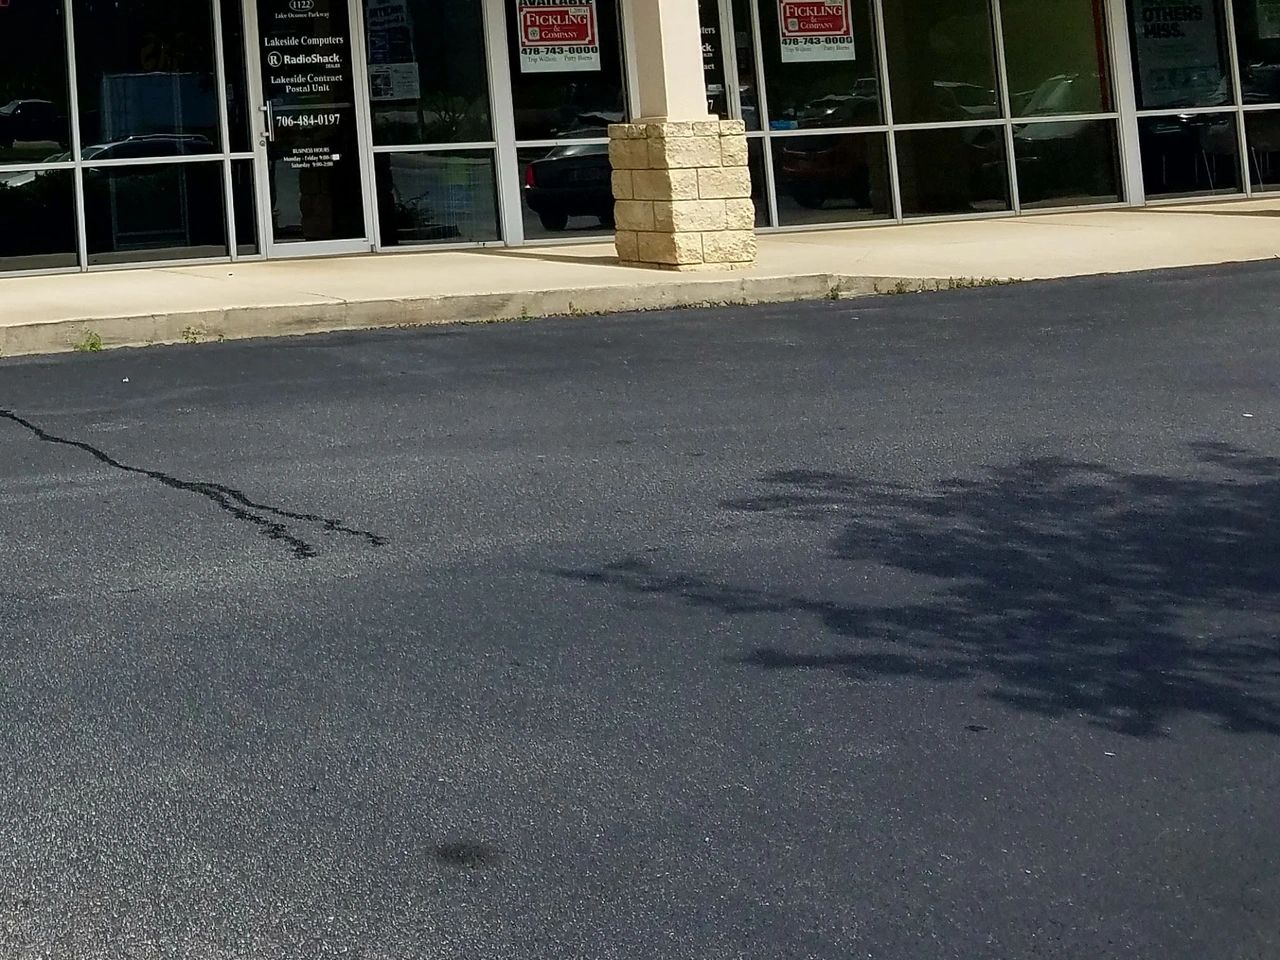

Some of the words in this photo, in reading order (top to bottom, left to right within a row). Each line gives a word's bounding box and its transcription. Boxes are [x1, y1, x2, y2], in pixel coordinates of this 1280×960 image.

[292, 0, 311, 9] 1122
[785, 5, 842, 16] FICKLING
[526, 13, 587, 26] FICKLING
[799, 21, 834, 30] COMPANY
[541, 31, 578, 39] COMPANY
[264, 36, 300, 47] Lakeside
[301, 35, 344, 47] Computers
[520, 46, 599, 56] 478-743-0000
[284, 53, 340, 65] RadioShack
[270, 73, 307, 84] Lakeside
[307, 73, 343, 83] Contract
[285, 84, 311, 93] Postal
[312, 83, 330, 92] Unit
[276, 114, 341, 128] 706-484-0197
